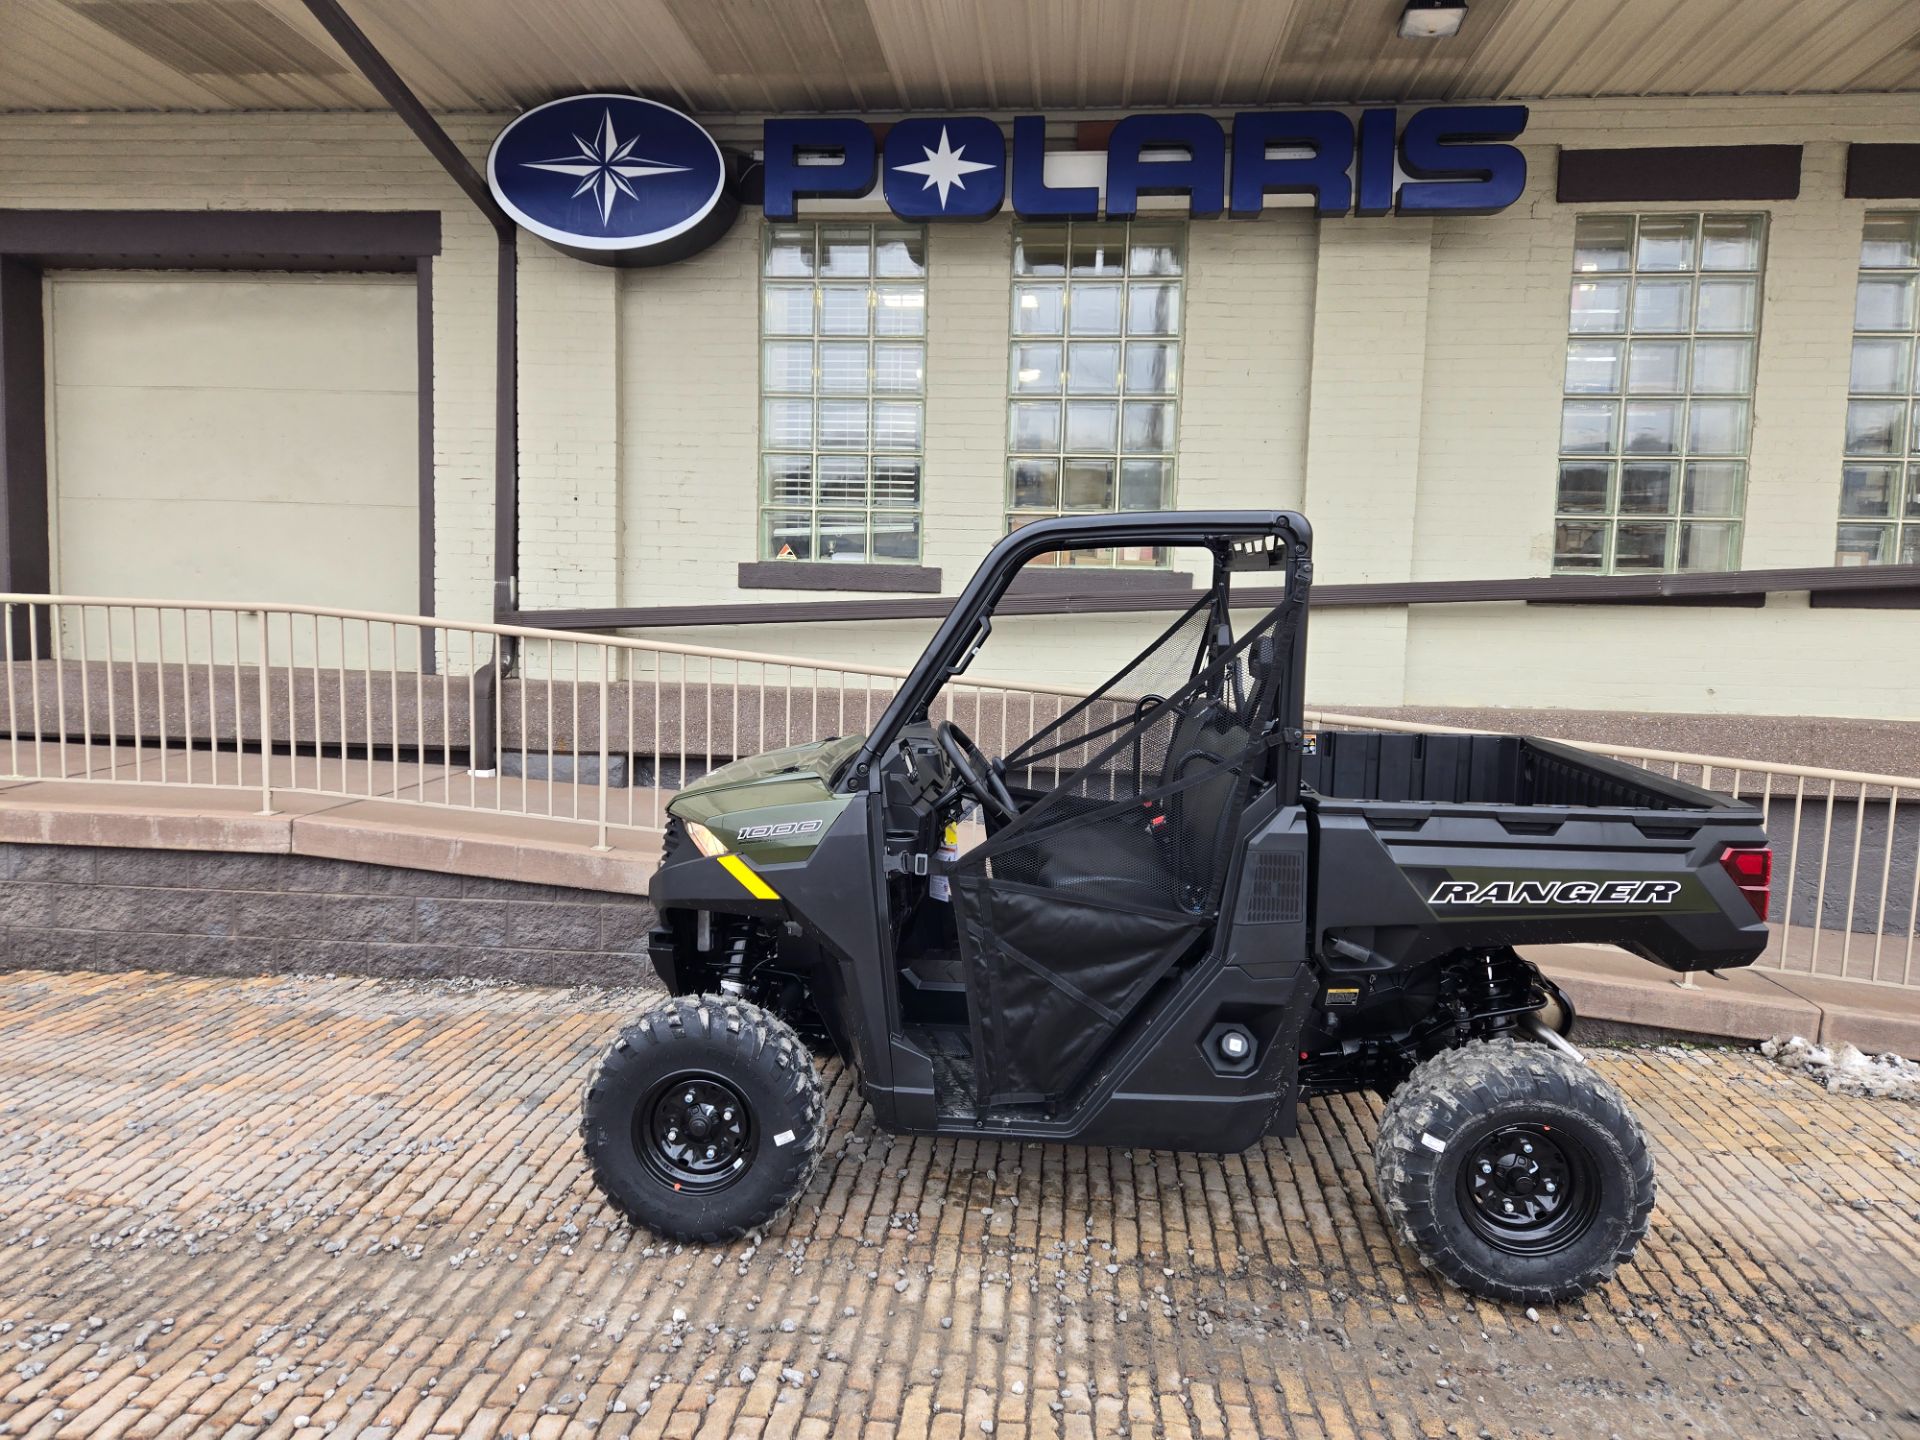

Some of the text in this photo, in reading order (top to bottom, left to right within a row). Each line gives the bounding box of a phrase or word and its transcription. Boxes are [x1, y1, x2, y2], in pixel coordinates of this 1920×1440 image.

[763, 105, 1528, 221] POLARIS
[737, 820, 822, 840] 1000
[1428, 881, 1682, 904] RANGER
